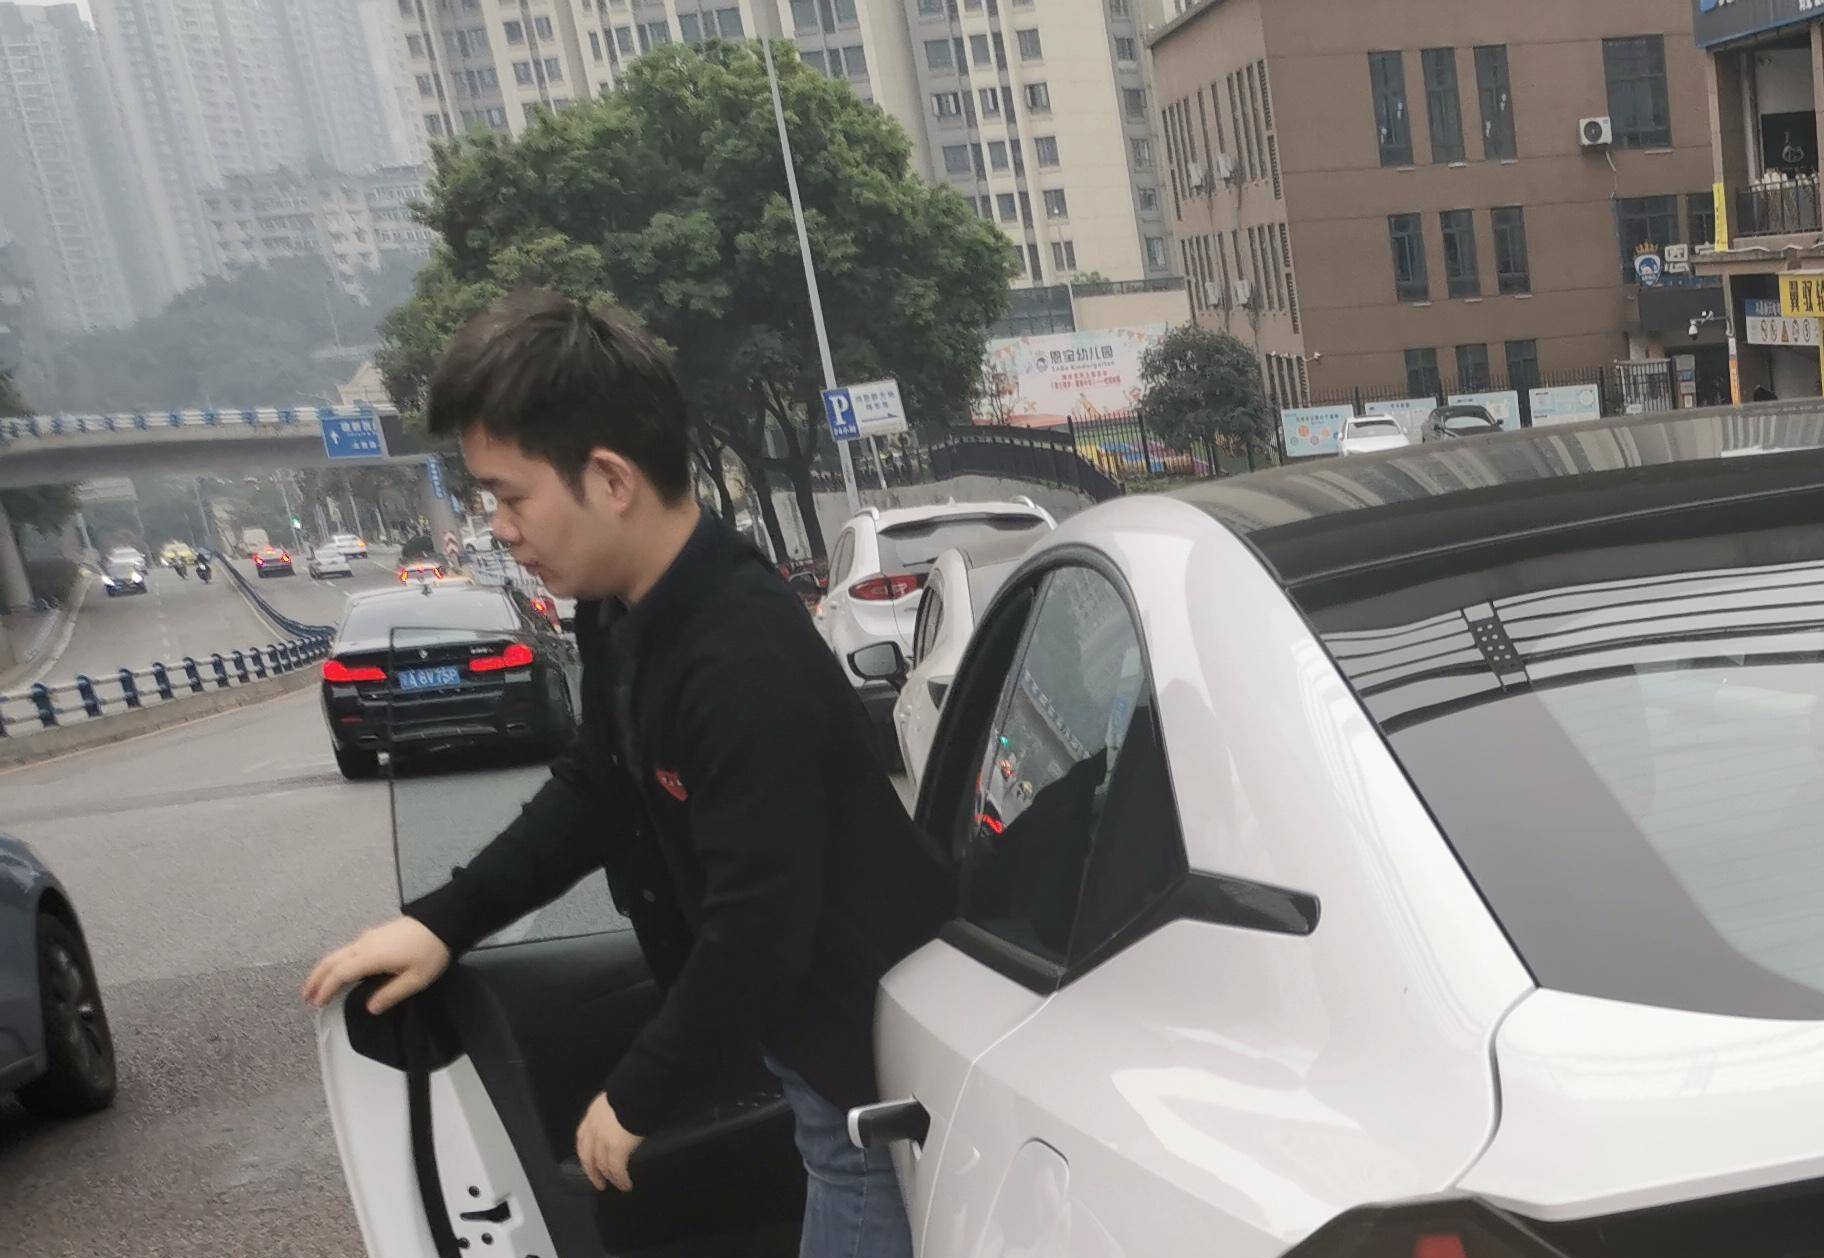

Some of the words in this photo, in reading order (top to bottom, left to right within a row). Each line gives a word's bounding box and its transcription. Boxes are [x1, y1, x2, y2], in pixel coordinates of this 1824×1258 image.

[1050, 345, 1114, 365] 恩宝幼儿园
[828, 395, 850, 425] P
